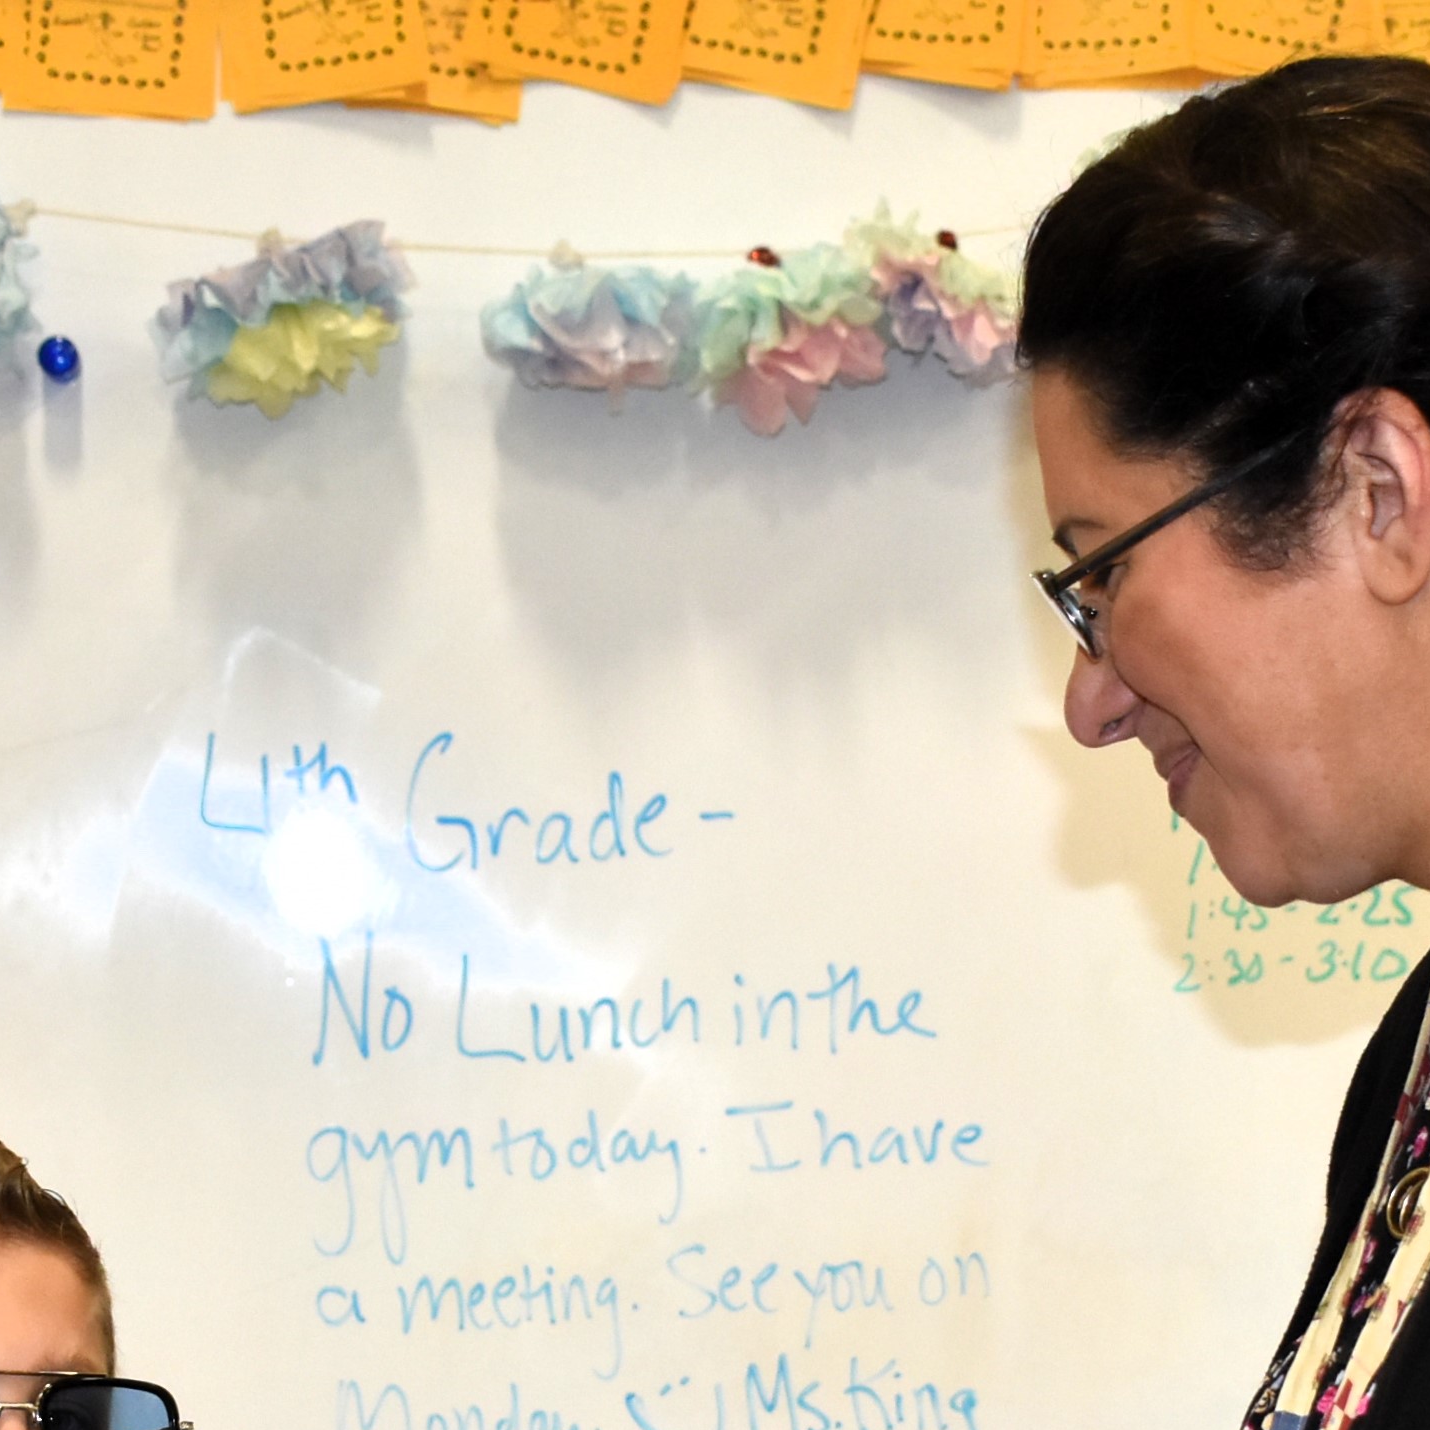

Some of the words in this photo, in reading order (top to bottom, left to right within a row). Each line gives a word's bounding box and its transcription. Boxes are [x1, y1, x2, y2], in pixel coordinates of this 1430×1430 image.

[200, 731, 359, 837] 4th
[311, 930, 416, 1067] No
[455, 953, 701, 1064] Lunch
[305, 1121, 476, 1267] gym
[724, 1098, 797, 1174] I
[813, 1107, 995, 1173] have
[314, 1283, 369, 1328] a
[665, 1242, 781, 1319] See
[794, 1259, 897, 1349] you
[917, 1250, 993, 1308] on
